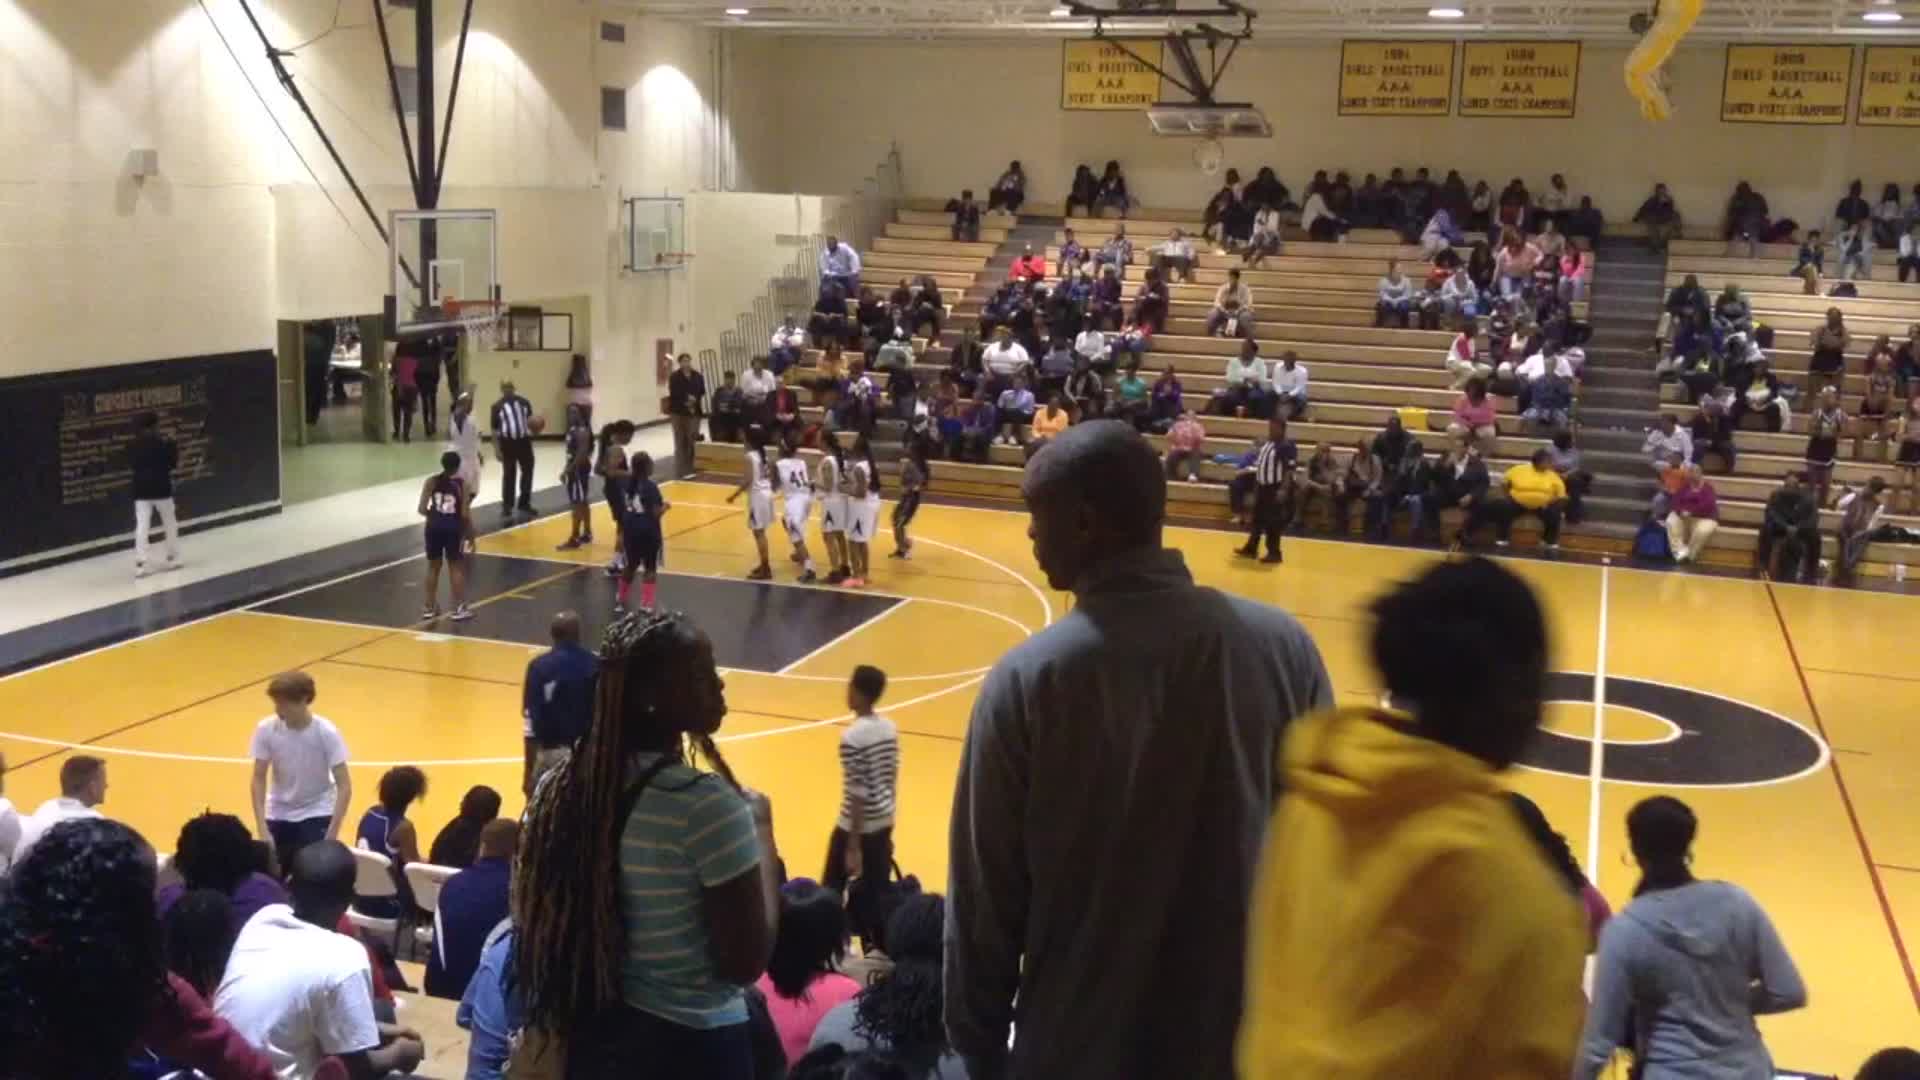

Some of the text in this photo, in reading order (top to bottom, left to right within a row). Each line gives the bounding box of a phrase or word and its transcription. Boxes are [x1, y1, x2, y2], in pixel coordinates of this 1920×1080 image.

[1382, 64, 1444, 76] BASKETBALL
[1503, 65, 1569, 77] BASKETBALL
[1772, 70, 1843, 83] BASKETBALL
[1096, 79, 1124, 89] AAA
[1377, 81, 1411, 93] AAA
[1501, 82, 1534, 94] AAA
[1768, 87, 1803, 98] AAA
